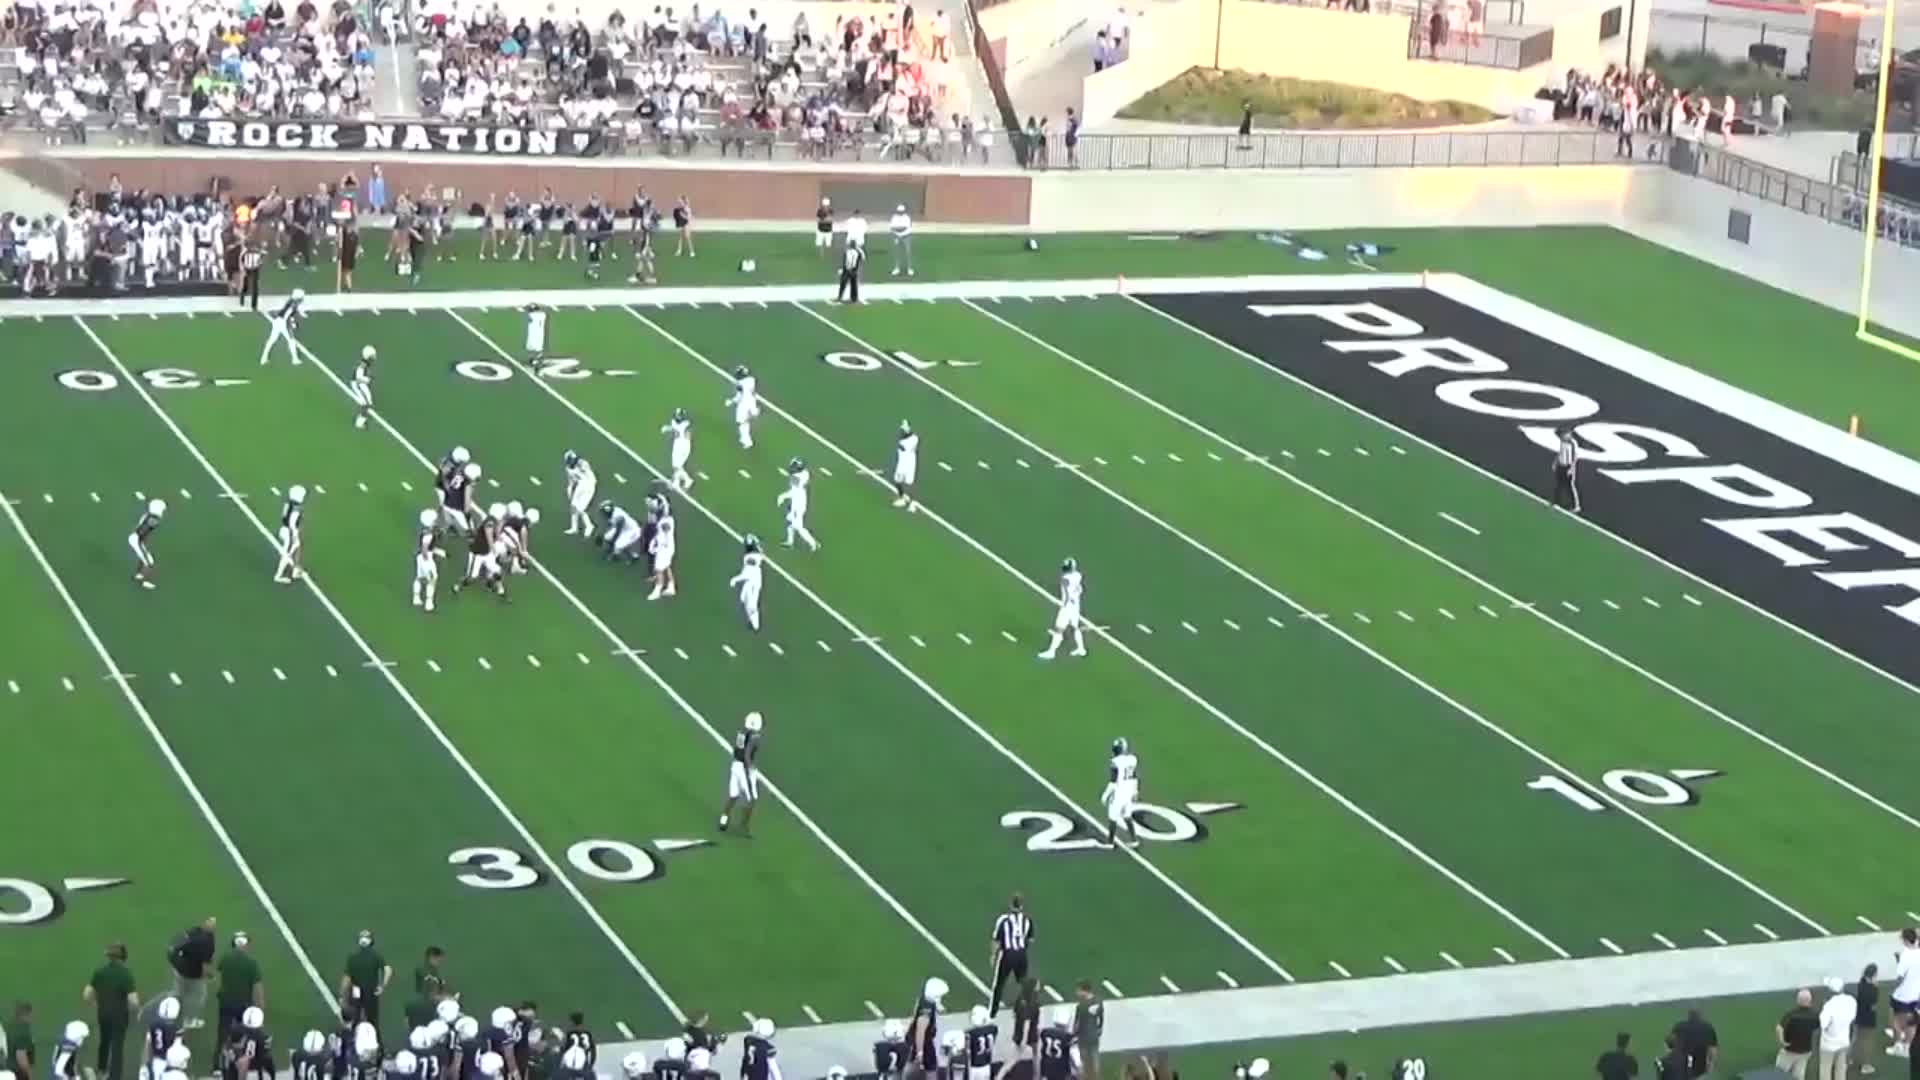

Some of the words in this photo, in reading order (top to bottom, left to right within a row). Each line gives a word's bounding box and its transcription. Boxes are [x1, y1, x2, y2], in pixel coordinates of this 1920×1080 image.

[207, 121, 339, 148] ROCK
[364, 125, 557, 155] NATION
[1526, 769, 1689, 811] 10
[1001, 803, 1197, 851] 20
[448, 840, 654, 888] 30
[1402, 1058, 1426, 1080] 20
